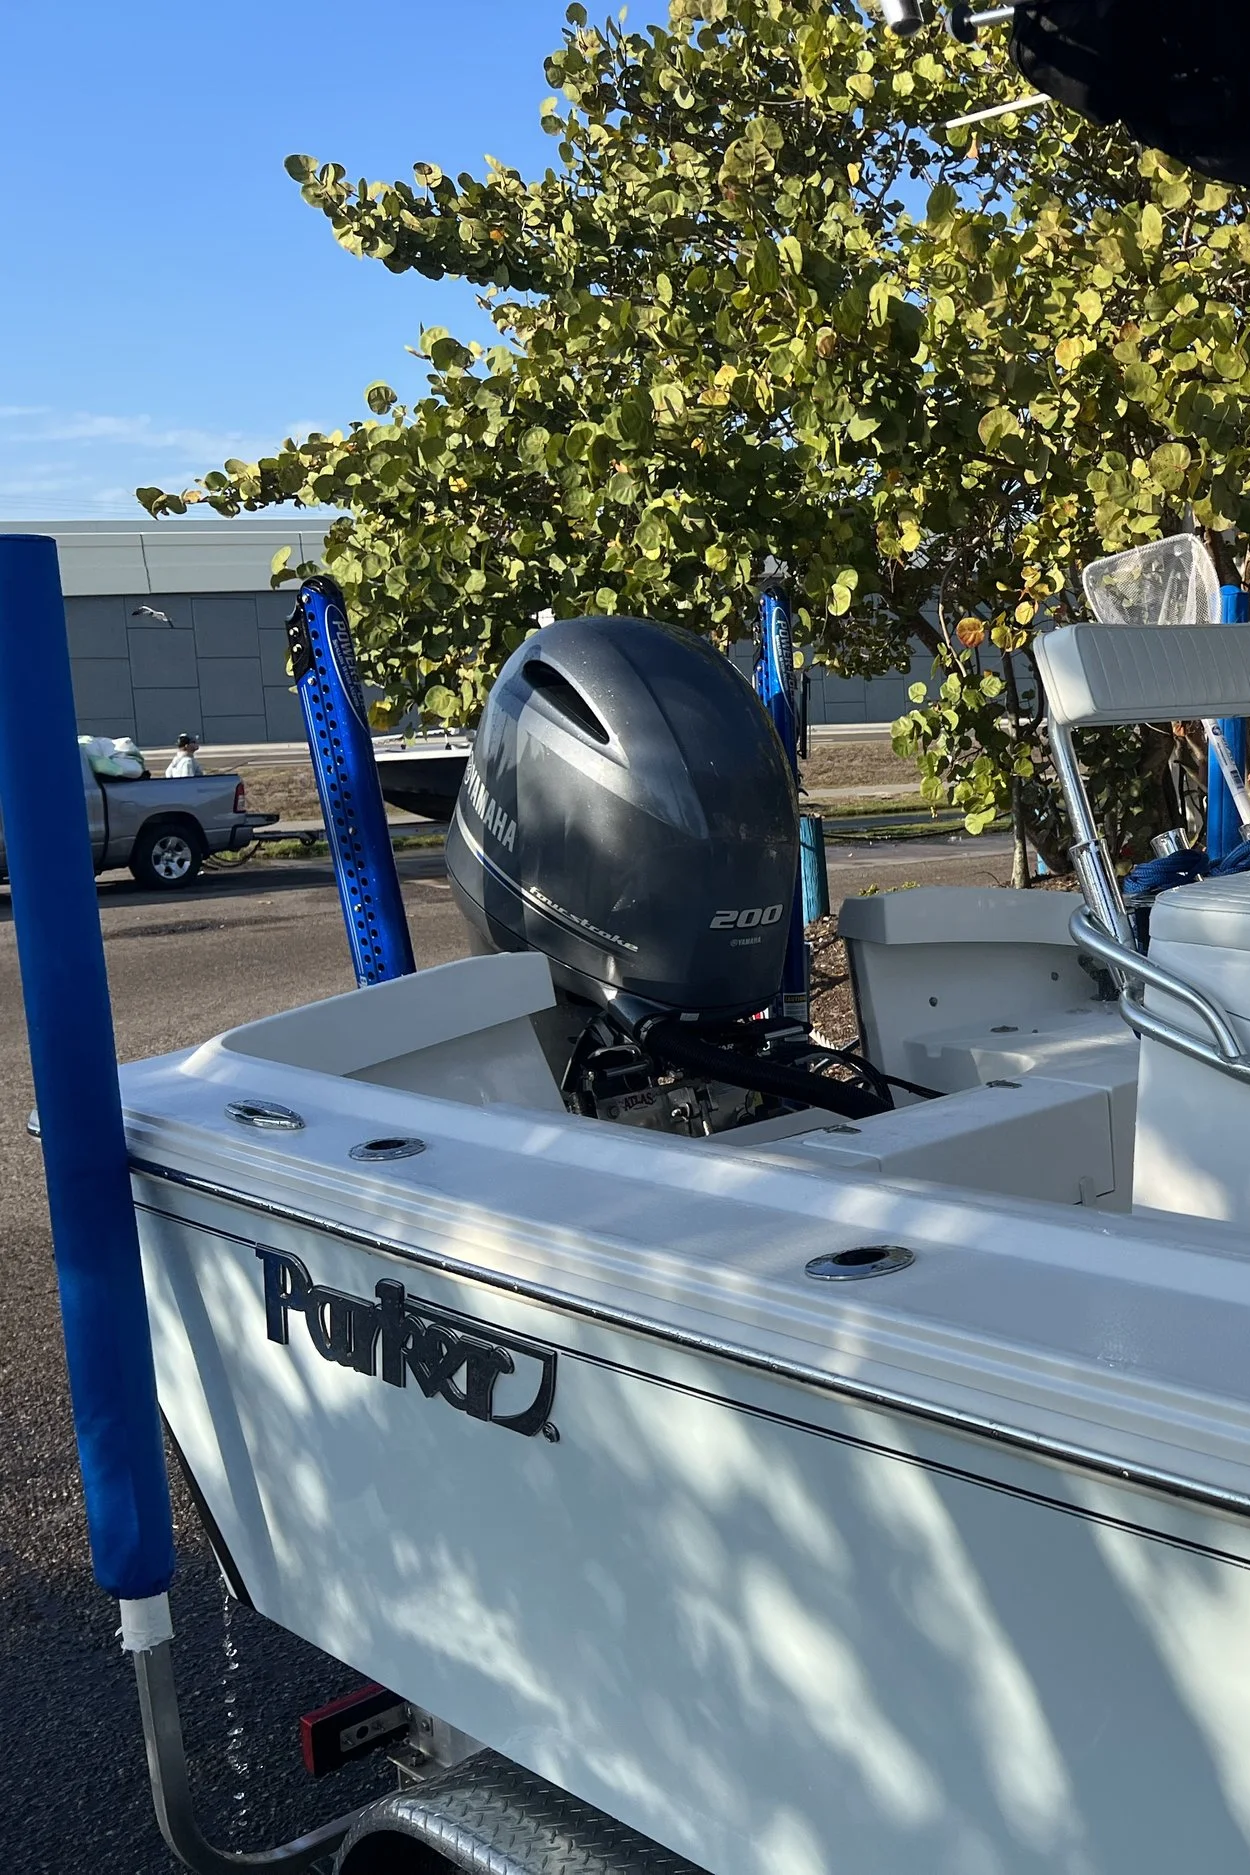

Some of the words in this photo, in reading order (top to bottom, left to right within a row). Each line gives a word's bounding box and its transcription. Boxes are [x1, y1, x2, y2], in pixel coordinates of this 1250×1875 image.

[467, 764, 517, 853] YAMAHA
[709, 903, 784, 929] 200
[738, 936, 762, 946] YAMAHA
[624, 1093, 654, 1111] ATLAS
[256, 1242, 557, 1437] Parker
